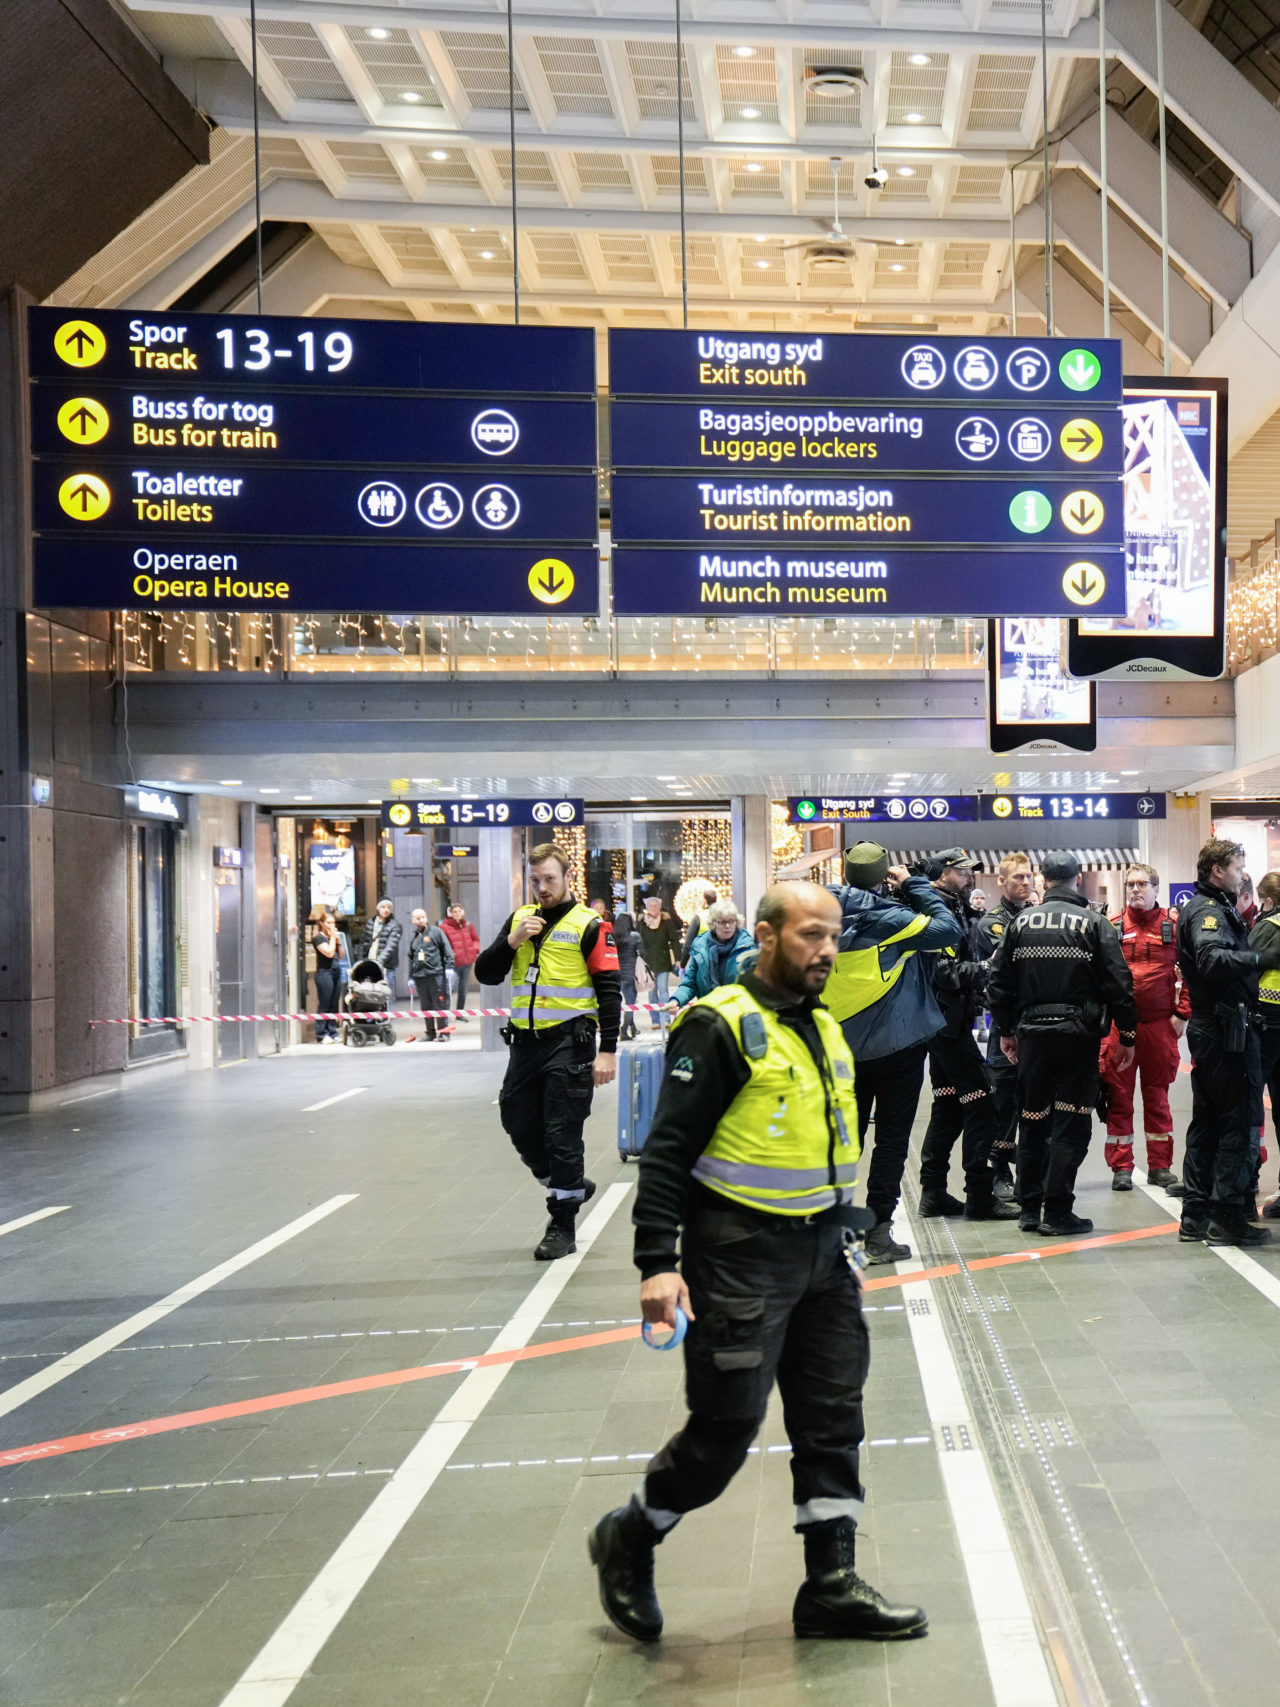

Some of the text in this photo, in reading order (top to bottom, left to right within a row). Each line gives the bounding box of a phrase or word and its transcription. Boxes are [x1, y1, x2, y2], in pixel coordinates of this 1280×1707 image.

[129, 320, 353, 372] Spor 13-19
[698, 337, 823, 365] Utgang syd
[912, 352, 933, 363] TAXI
[129, 346, 197, 370] Track
[699, 363, 807, 386] Exit south
[132, 396, 274, 427] Buss for tog
[699, 409, 923, 438] Bagasjeoppbevaring
[133, 423, 277, 448] Bus for train
[700, 435, 877, 462] Luggage lockers
[132, 471, 243, 496] Toaletter
[698, 484, 893, 511] Turistinformasjon
[132, 499, 213, 522] Toilets
[700, 510, 911, 531] Tourist information
[133, 548, 238, 574] Operaen
[699, 555, 887, 578] Munch museum
[133, 575, 289, 601] Opera House
[701, 582, 887, 603] Munch museum
[1126, 664, 1167, 673] JCDecaux
[417, 803, 509, 822] Spor 15-19
[822, 799, 875, 810] Utgang syd
[822, 810, 871, 818] Exit South
[1018, 797, 1109, 817] Spor 13-14
[1018, 807, 1044, 817] Track
[417, 813, 446, 825] Track
[1017, 911, 1088, 934] POLITI
